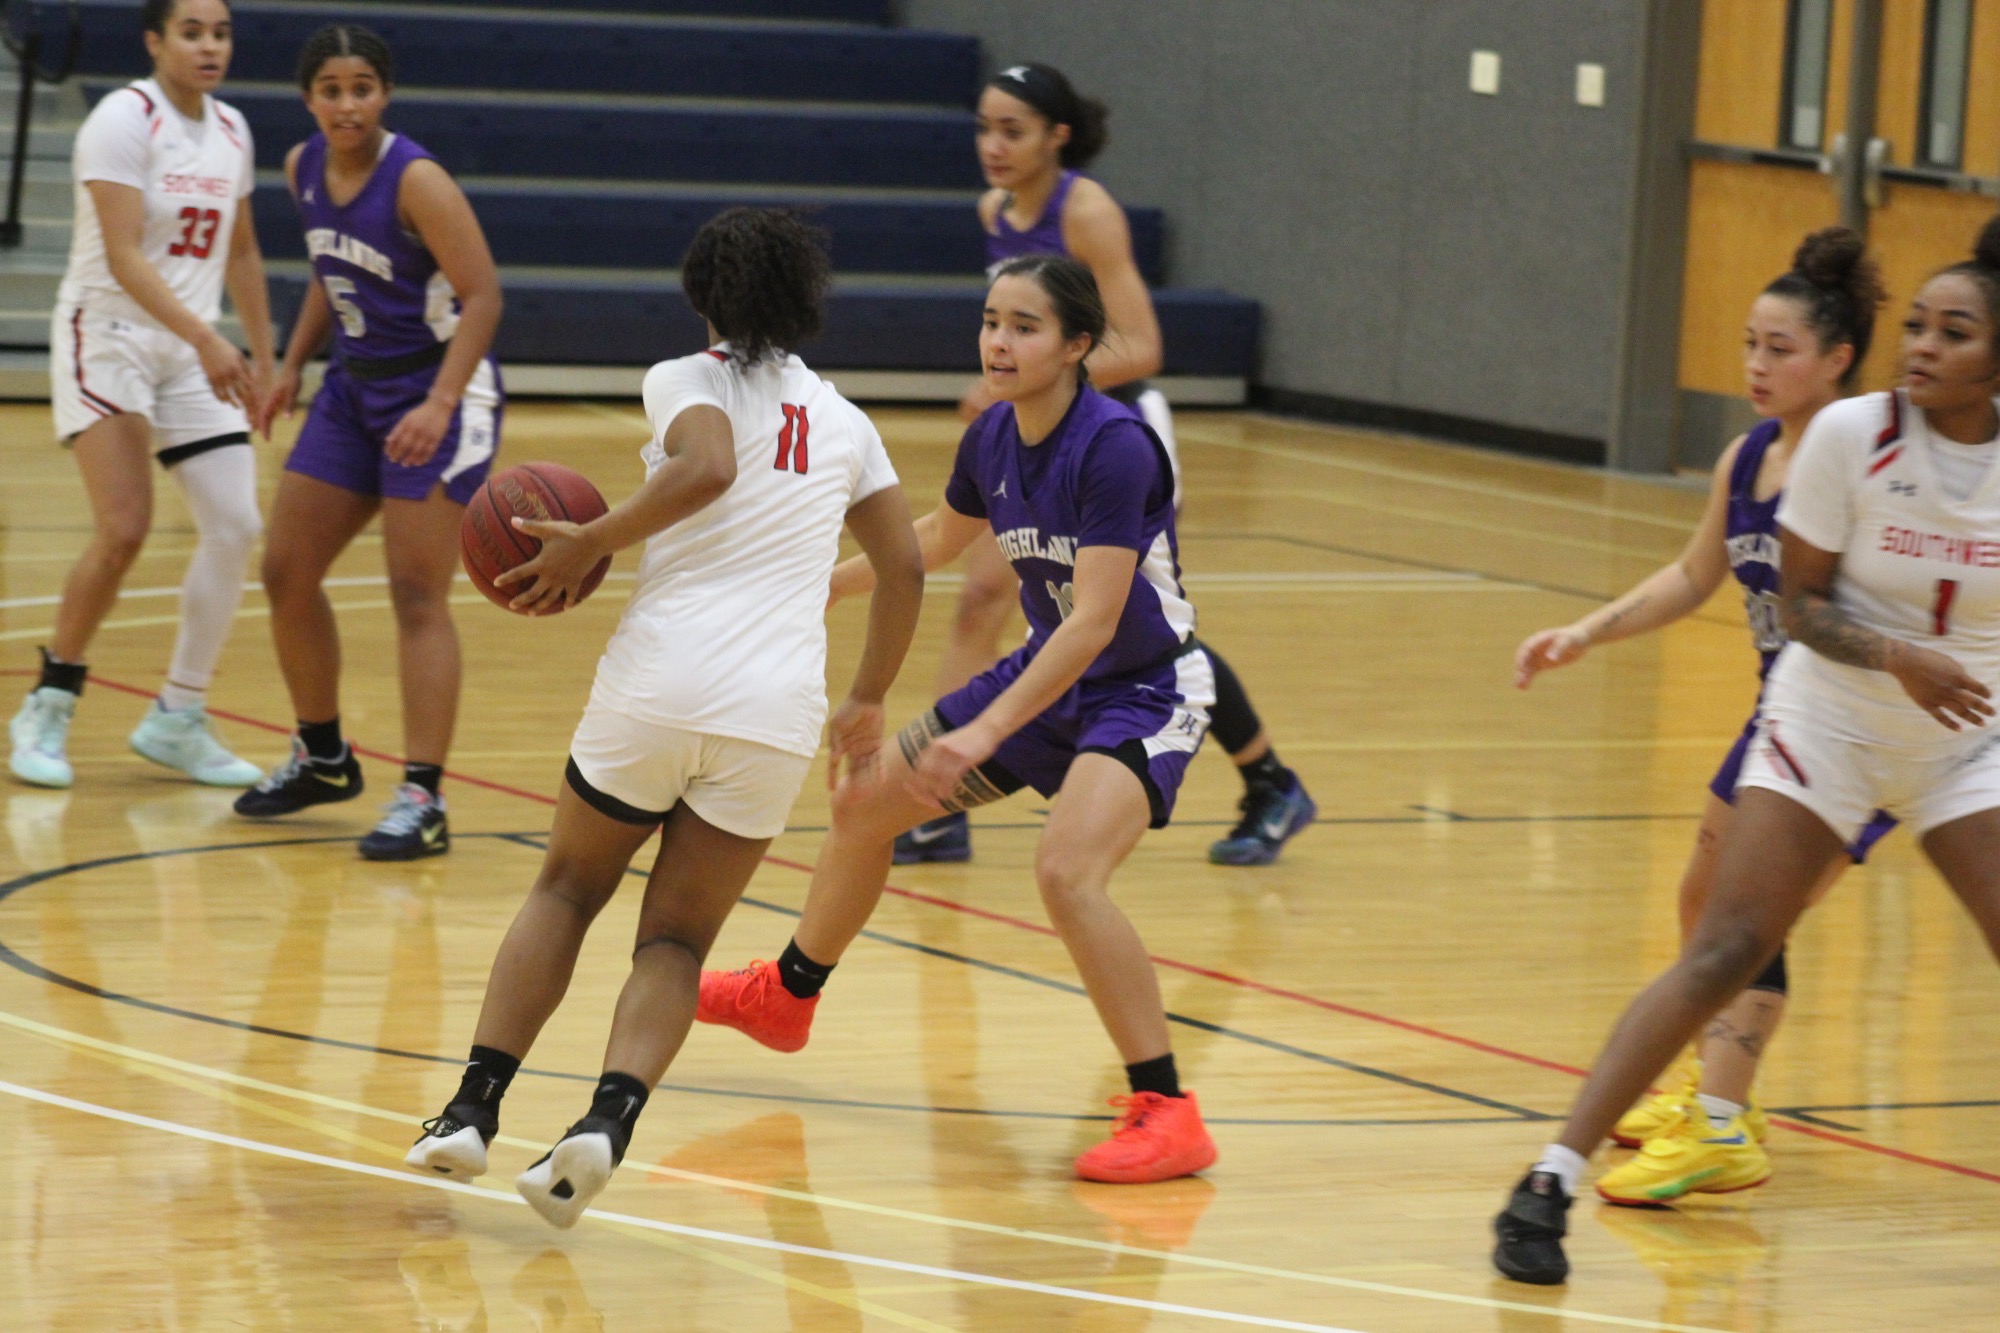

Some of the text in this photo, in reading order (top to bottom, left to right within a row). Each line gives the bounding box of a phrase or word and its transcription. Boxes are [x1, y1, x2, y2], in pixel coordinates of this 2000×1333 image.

[168, 206, 221, 259] 33
[323, 275, 366, 338] 5
[773, 402, 809, 475] 11
[1045, 579, 1074, 620] 1
[1931, 578, 1959, 636] 1
